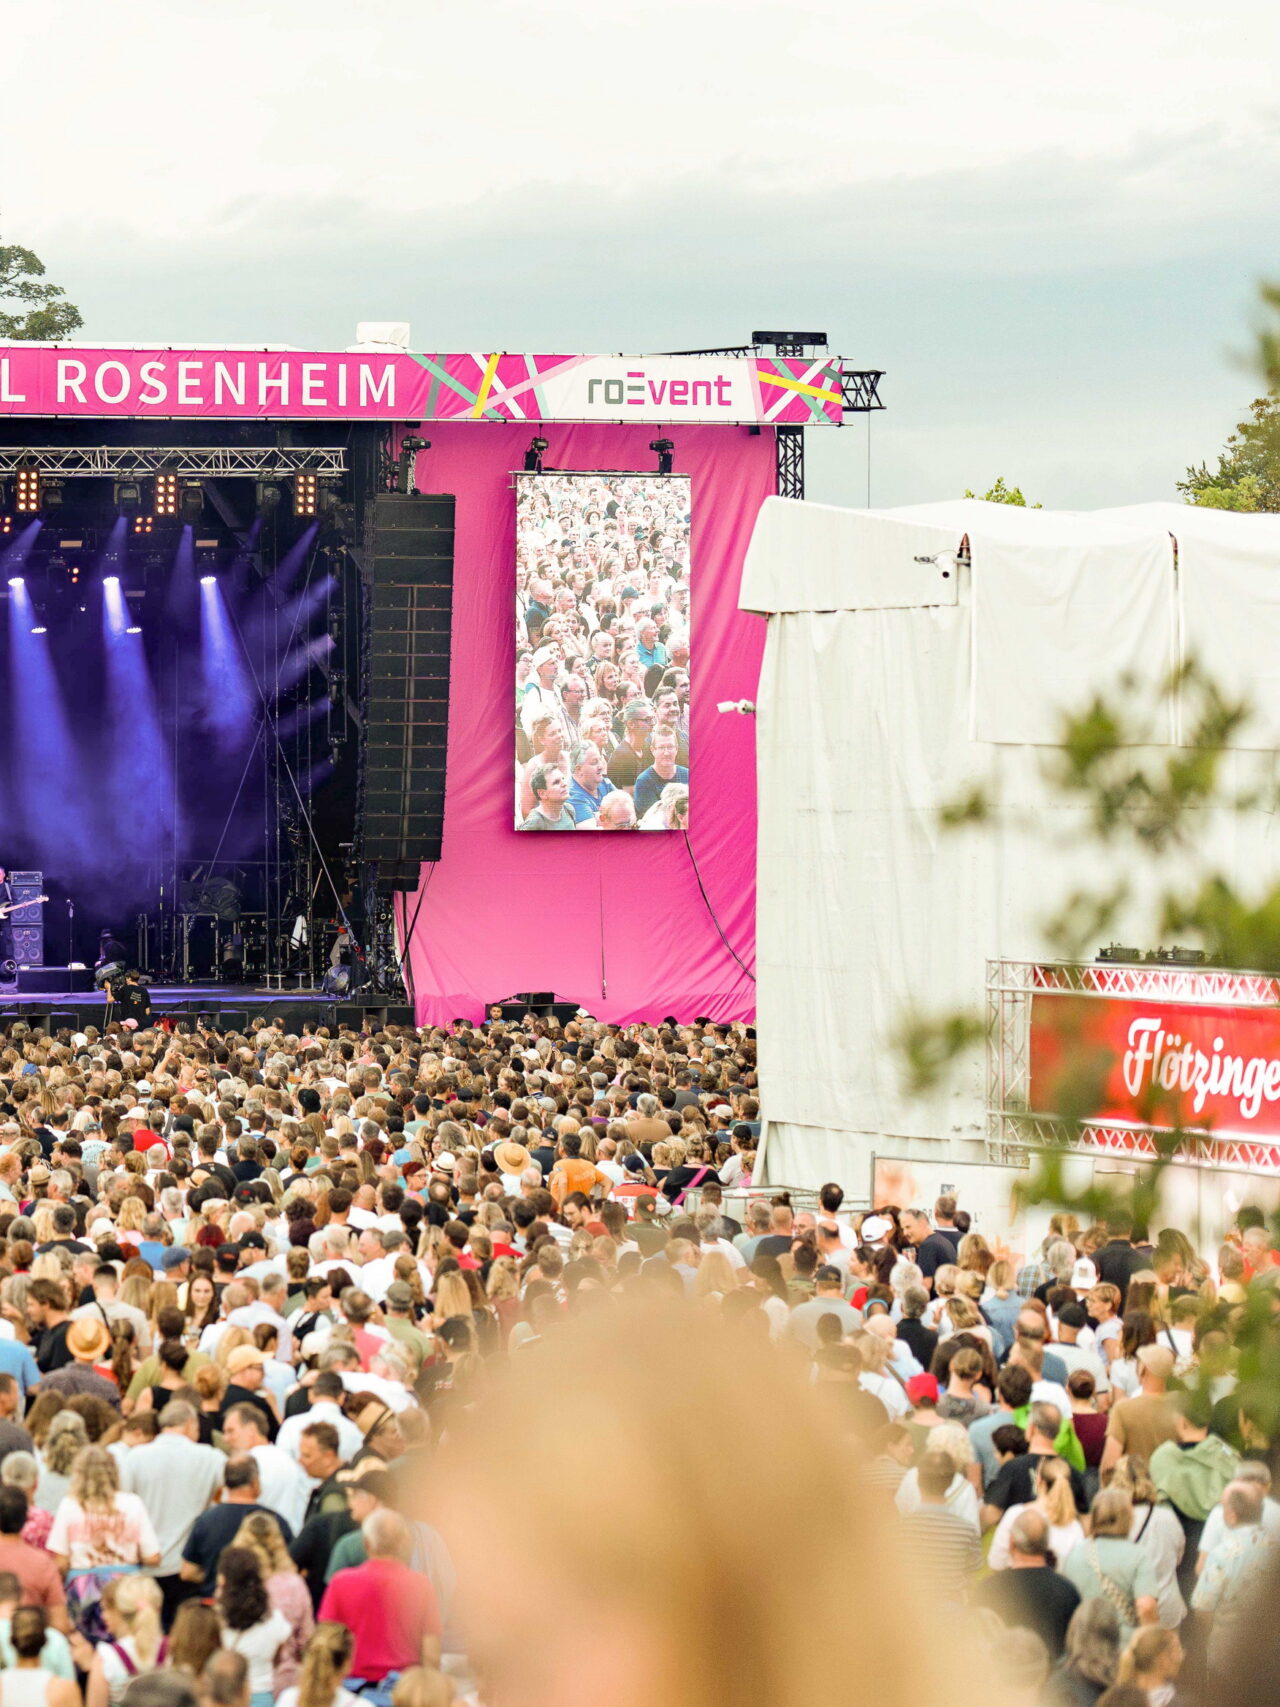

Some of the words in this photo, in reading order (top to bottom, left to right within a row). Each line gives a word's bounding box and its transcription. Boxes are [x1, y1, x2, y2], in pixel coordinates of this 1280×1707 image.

[56, 359, 396, 407] ROSENHEIM
[588, 372, 732, 406] roEvent
[1123, 1017, 1280, 1119] Flötzinge
